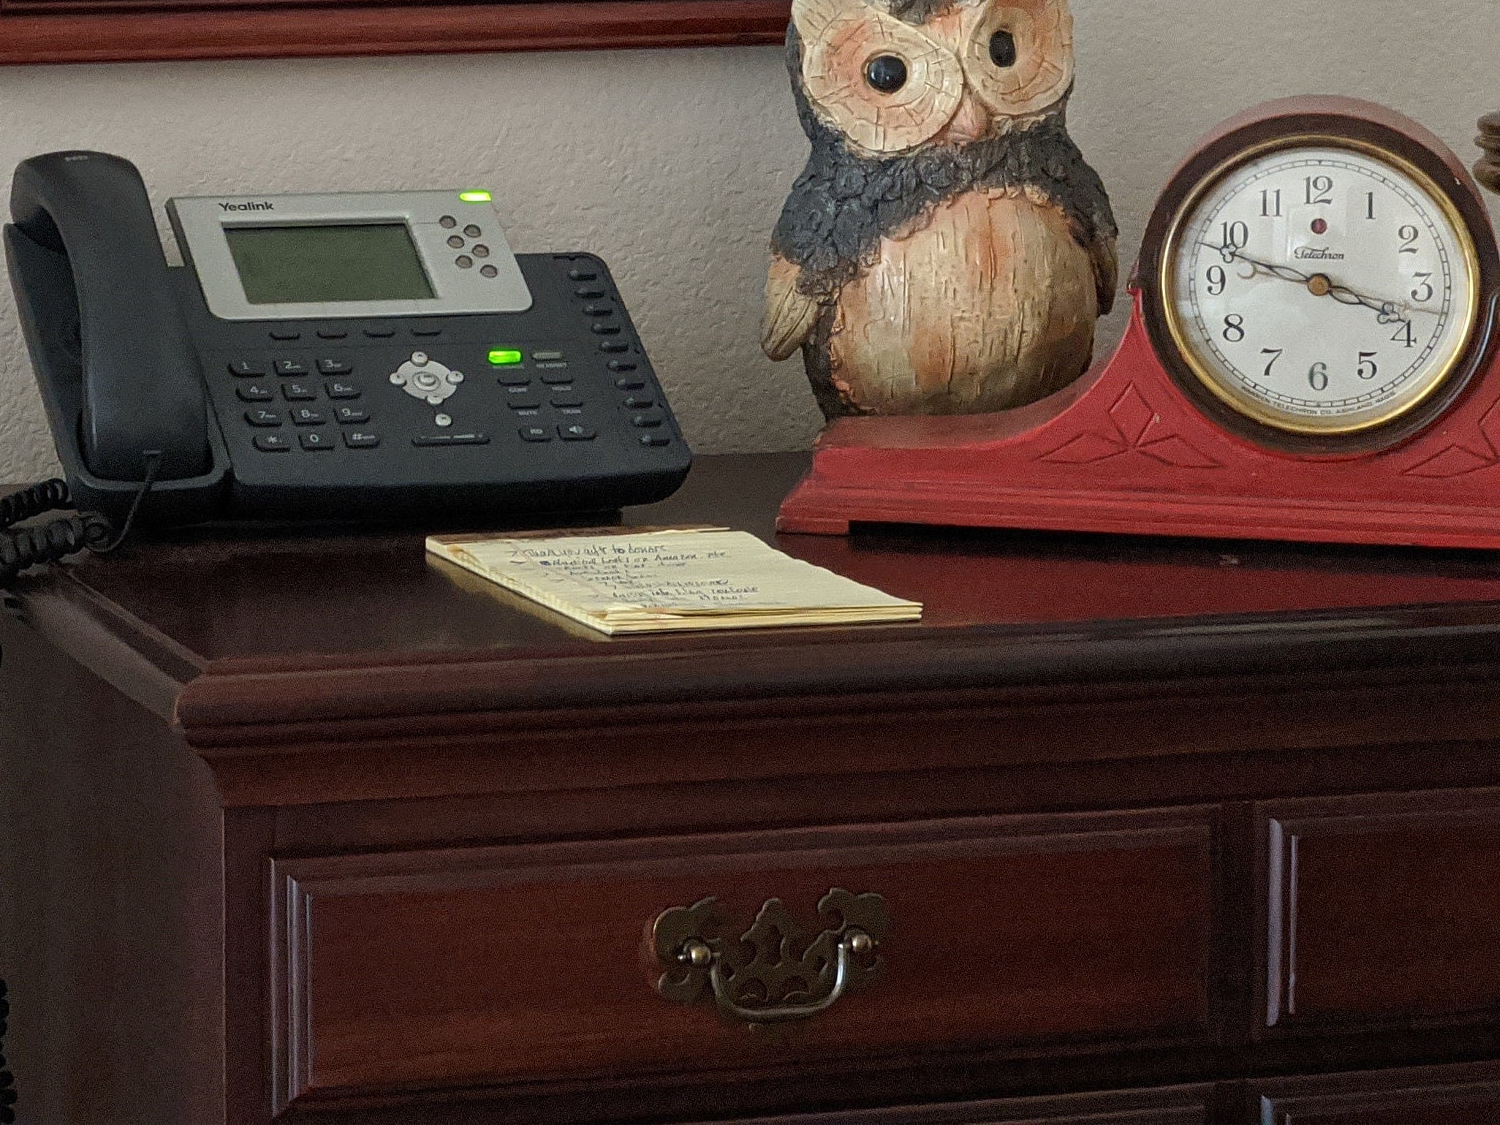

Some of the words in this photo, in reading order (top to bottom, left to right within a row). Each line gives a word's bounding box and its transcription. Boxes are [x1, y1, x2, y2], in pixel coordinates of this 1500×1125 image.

[1259, 188, 1283, 217] 11
[1302, 175, 1334, 205] 12
[218, 201, 275, 212] Yealink
[1364, 191, 1377, 220] 1
[1219, 221, 1249, 250] 10
[1397, 224, 1419, 254] 2
[1205, 265, 1226, 295] 9
[1410, 272, 1434, 302] 3
[1222, 313, 1245, 343] 8
[1389, 318, 1417, 348] 4
[1259, 347, 1283, 377] 7
[1307, 362, 1329, 391] 6
[1356, 351, 1378, 380] 5
